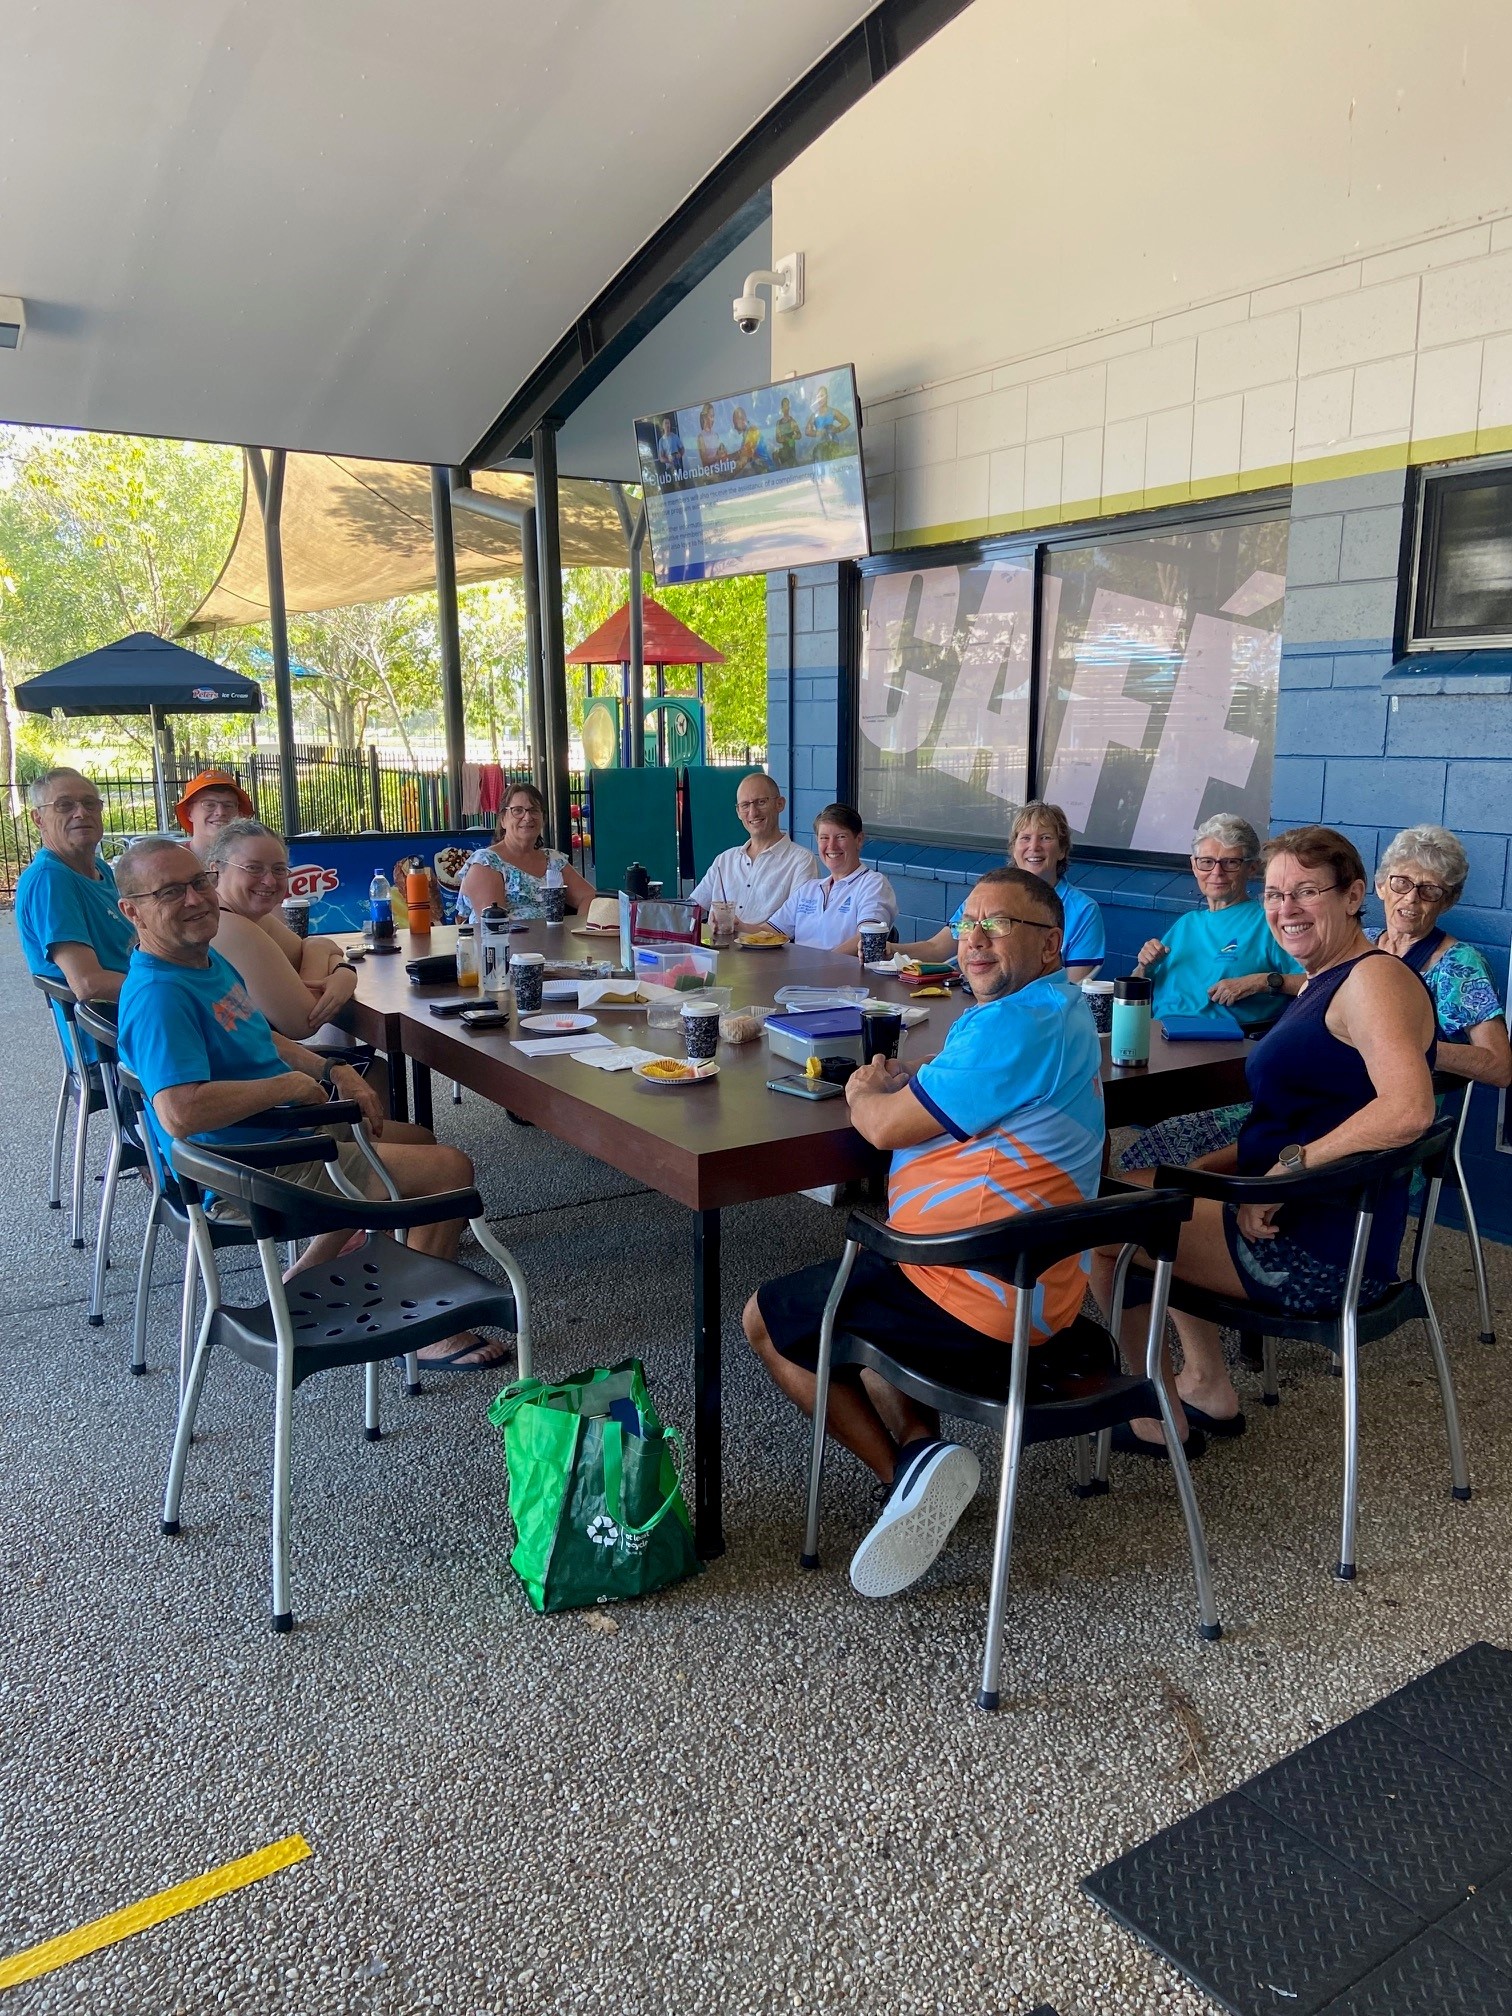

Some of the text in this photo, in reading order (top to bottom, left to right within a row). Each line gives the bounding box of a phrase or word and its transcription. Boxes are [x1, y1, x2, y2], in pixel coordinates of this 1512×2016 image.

[674, 459, 737, 482] Membership
[728, 486, 737, 494] the
[765, 479, 771, 487] of
[192, 688, 218, 699] Peters
[634, 1531, 650, 1541] least
